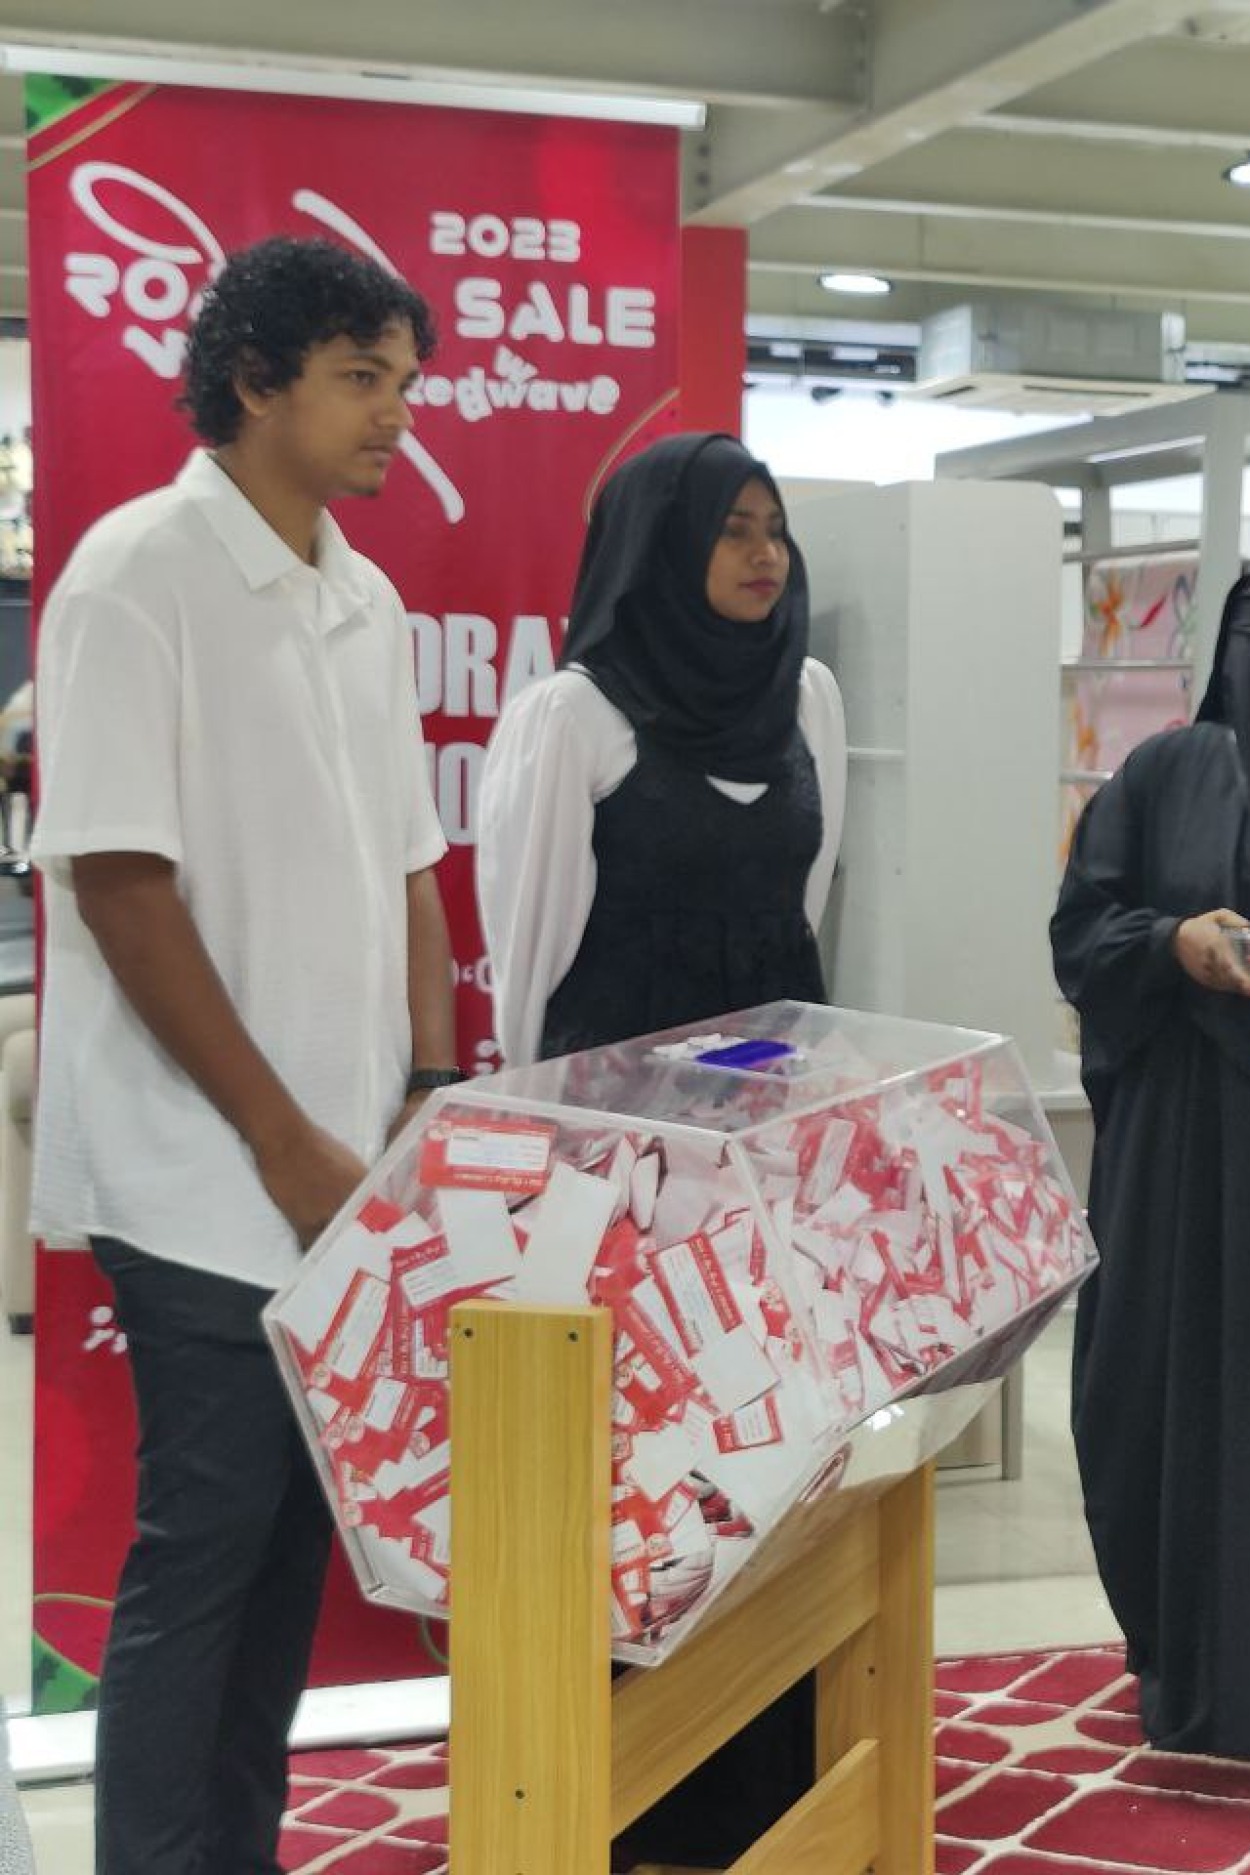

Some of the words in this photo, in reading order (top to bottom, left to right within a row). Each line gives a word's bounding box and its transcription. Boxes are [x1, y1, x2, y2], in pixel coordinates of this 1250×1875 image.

[430, 212, 581, 262] 2023
[455, 277, 656, 348] SALE
[404, 612, 571, 718] DRA
